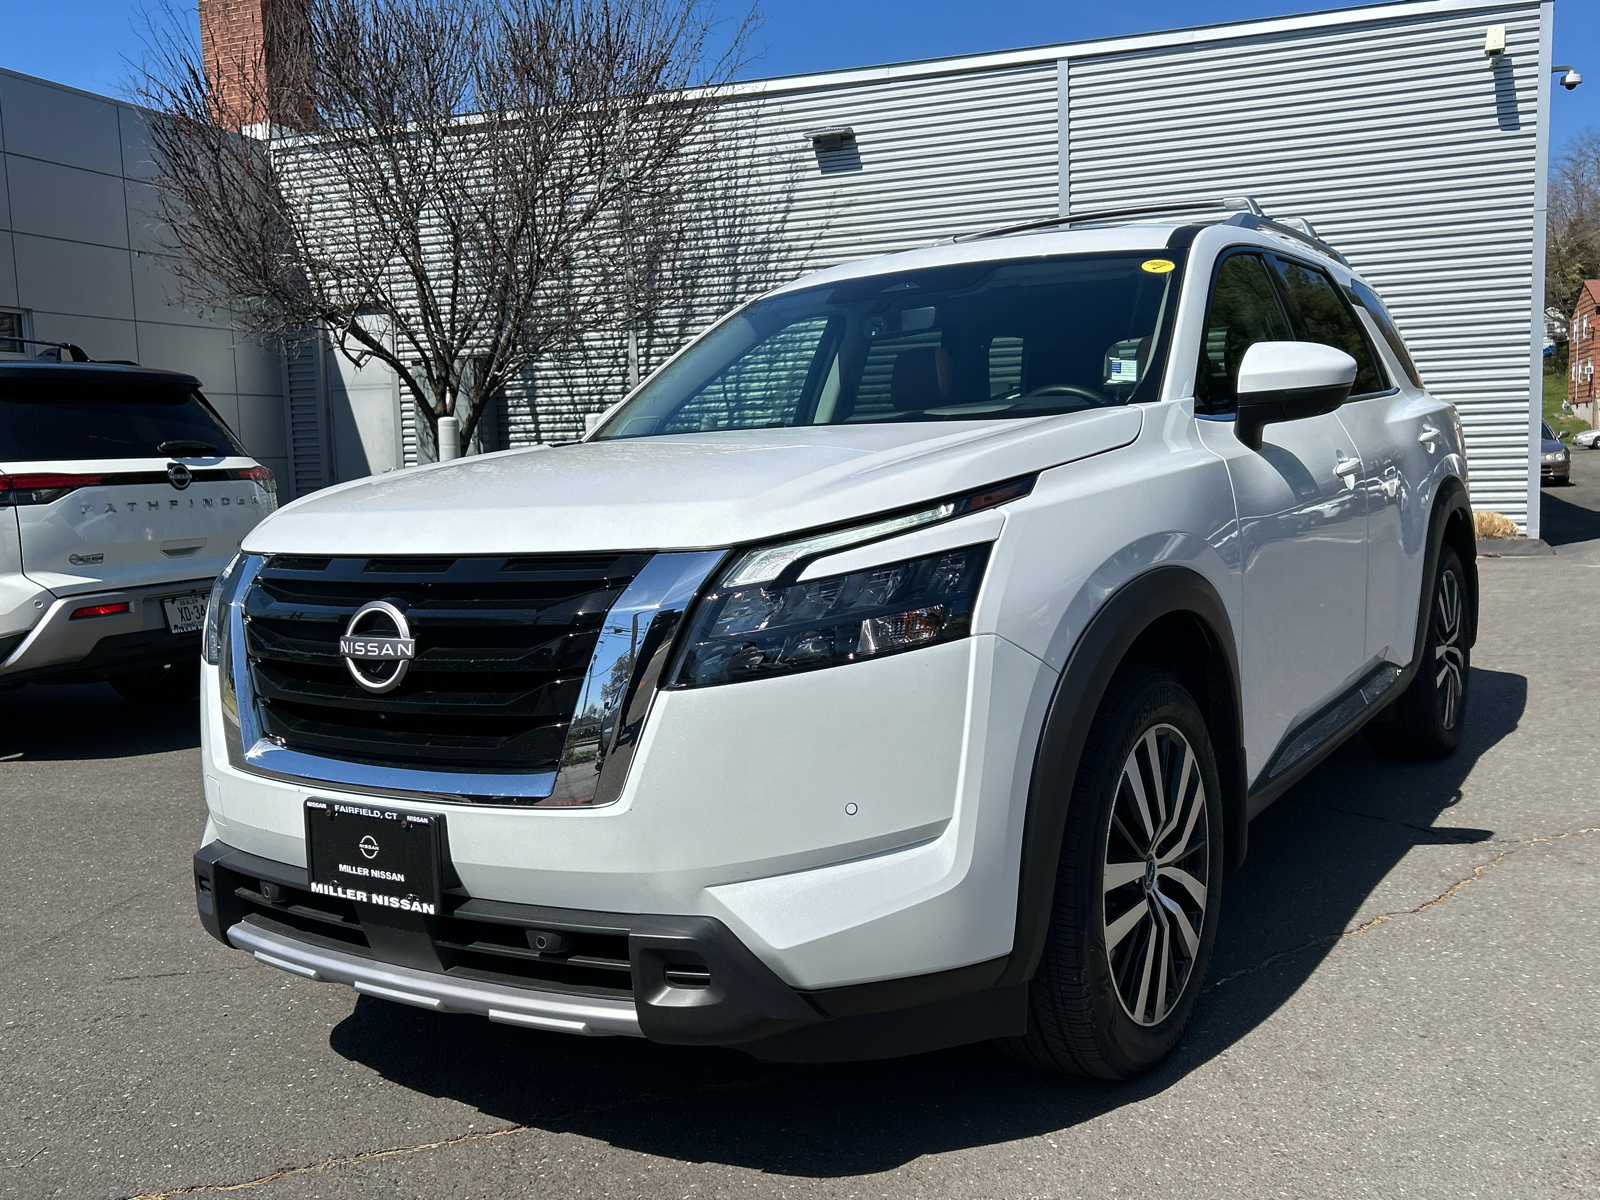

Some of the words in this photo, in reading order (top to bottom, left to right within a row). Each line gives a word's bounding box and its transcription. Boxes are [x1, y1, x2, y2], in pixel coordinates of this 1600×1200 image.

[80, 495, 259, 514] PATHFINDER
[171, 626, 197, 634] MILLER
[340, 640, 412, 656] NISSAN
[306, 800, 327, 809] NISSAN
[334, 804, 383, 819] FAIRFIELD,
[384, 811, 398, 820] CT
[406, 815, 429, 824] NISSAN
[358, 843, 380, 851] NISSAN
[338, 863, 370, 877] MILLER
[370, 869, 405, 882] NISSAN
[310, 882, 368, 902] MILLER
[371, 894, 435, 915] NISSAN
